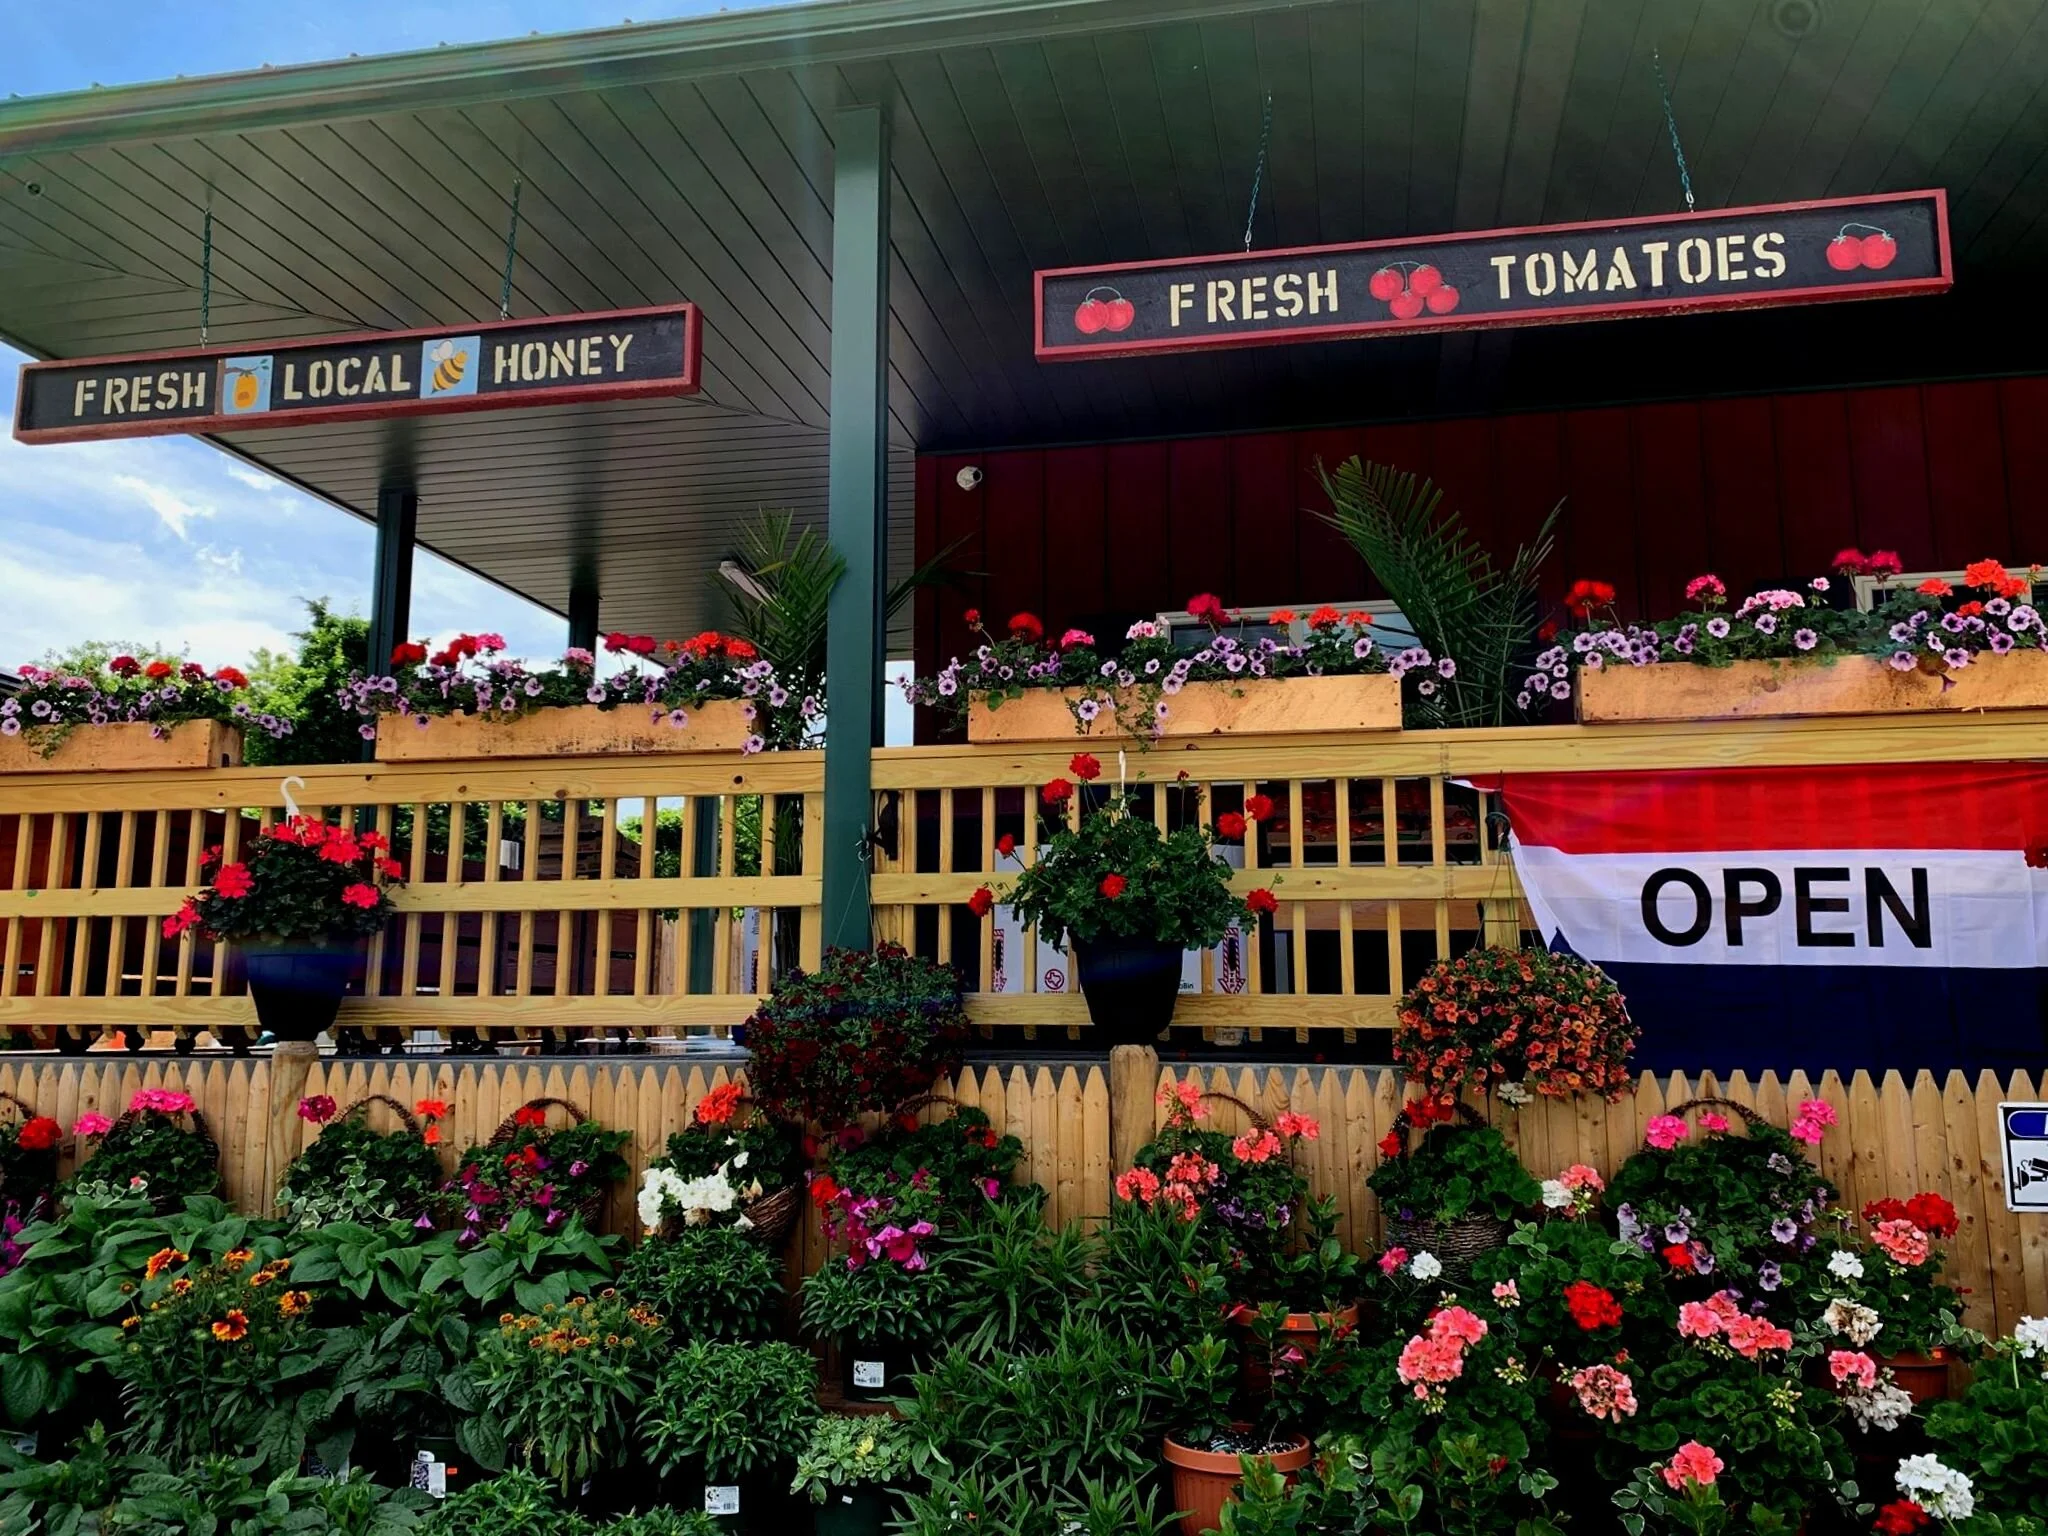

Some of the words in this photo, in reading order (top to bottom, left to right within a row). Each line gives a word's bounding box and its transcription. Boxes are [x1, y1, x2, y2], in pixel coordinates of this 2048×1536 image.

[1170, 269, 1339, 327] FRESH
[1490, 231, 1786, 300] TOMATOES
[74, 371, 206, 420] FRESH
[283, 354, 411, 400] LOCAL
[494, 333, 634, 384] HONEY
[1640, 867, 1932, 949] OPEN
